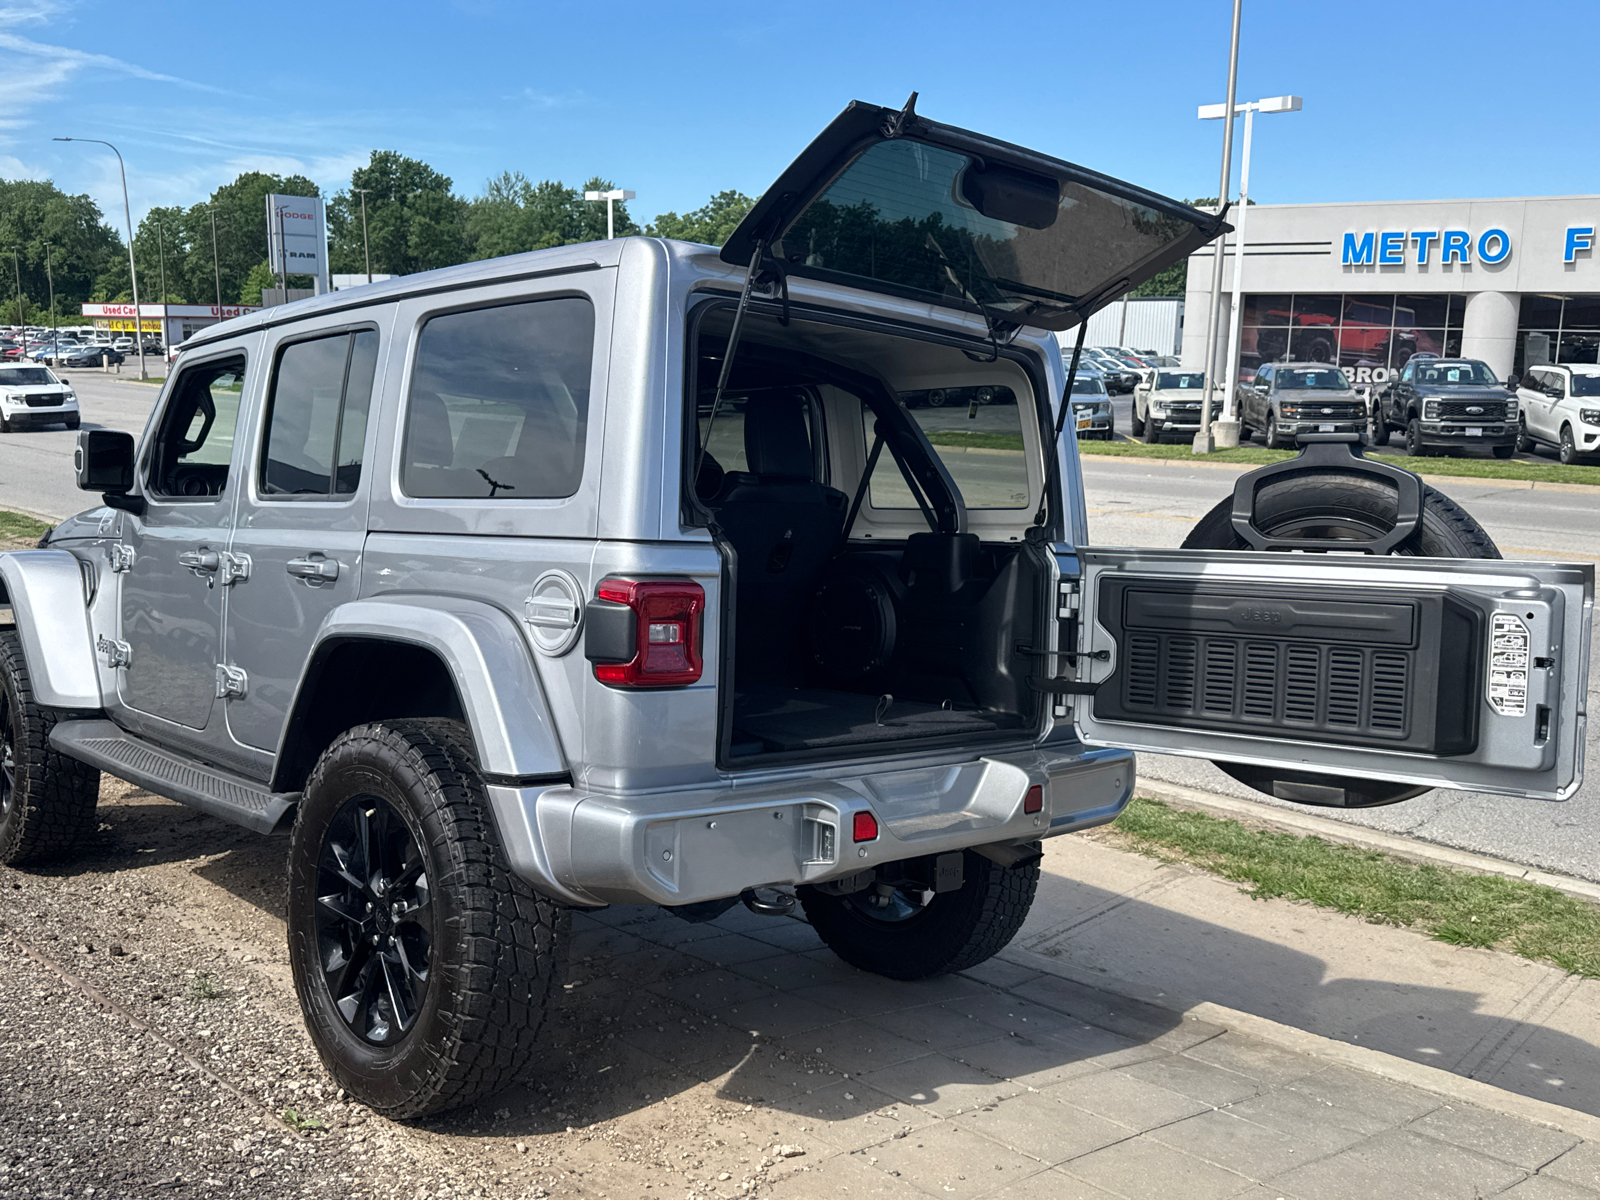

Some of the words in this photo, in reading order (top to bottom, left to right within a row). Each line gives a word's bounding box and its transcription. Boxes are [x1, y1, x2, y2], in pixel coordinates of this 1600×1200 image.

[1341, 228, 1512, 265] METRO
[1563, 226, 1595, 264] F
[102, 305, 122, 315] Used
[122, 306, 137, 315] Car
[211, 306, 240, 316] Used
[96, 321, 114, 330] Used
[1240, 607, 1282, 624] Jeep
[97, 633, 110, 654] Jee
[938, 866, 961, 878] Jeep
